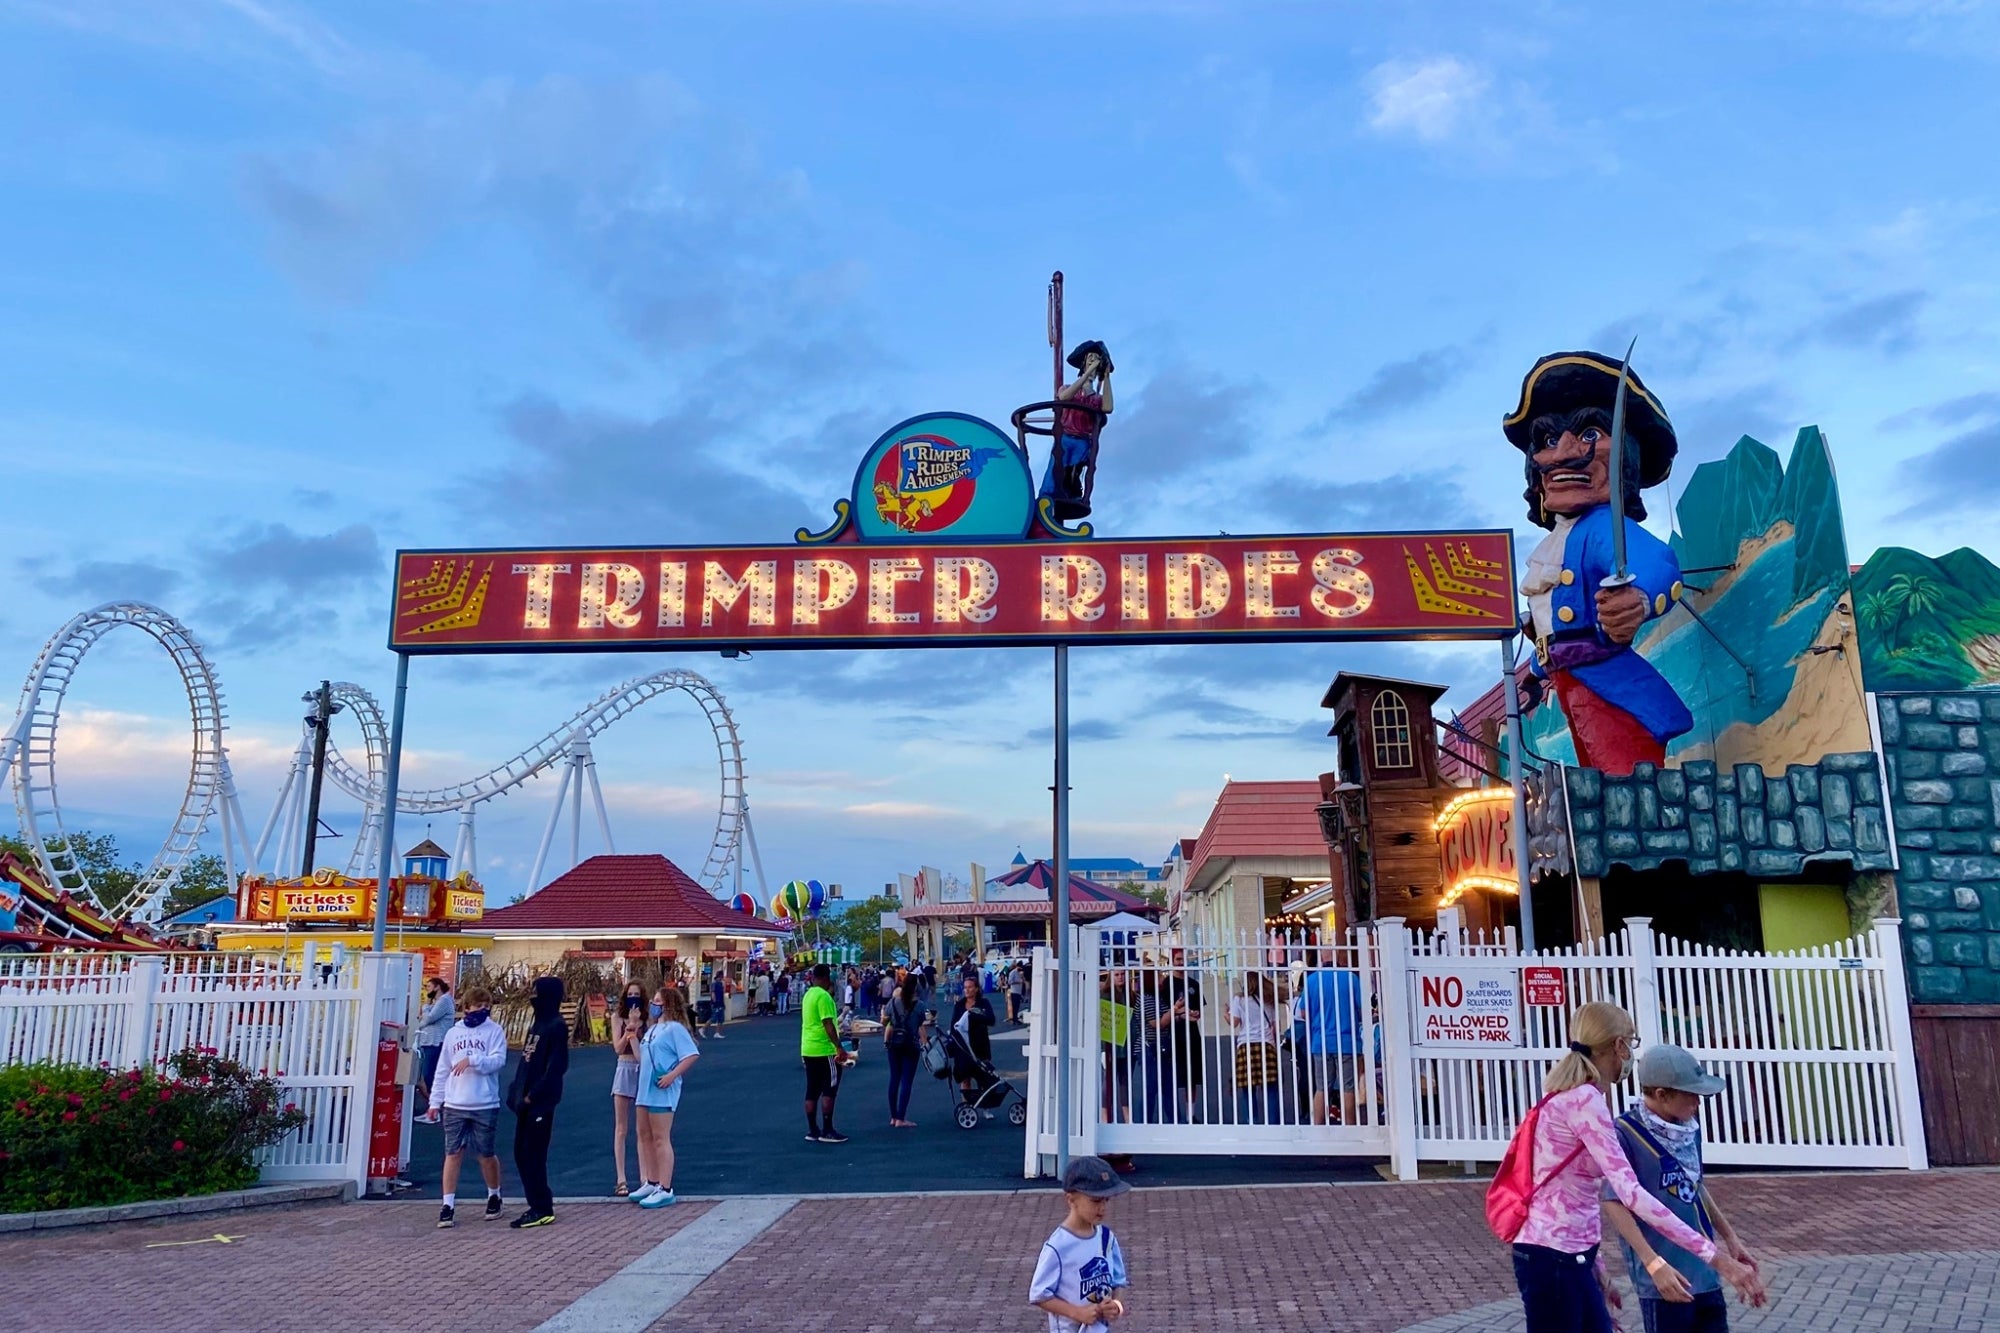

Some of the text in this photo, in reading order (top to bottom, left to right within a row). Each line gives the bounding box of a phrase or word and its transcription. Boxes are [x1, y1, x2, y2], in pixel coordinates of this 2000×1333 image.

[903, 442, 971, 463] TRIMPER
[917, 461, 958, 476] RIDES
[905, 467, 971, 489] AMUSEMENTS
[512, 548, 1374, 628] TRIMPER RIDES
[1442, 807, 1514, 883] COVE
[284, 893, 356, 905] Tickets
[452, 895, 481, 907] Tickets
[289, 904, 350, 914] ALL RIDES
[1479, 980, 1499, 989] BIKES
[1422, 976, 1463, 1008] NO
[1466, 989, 1512, 997] SKATEBOARDS
[1467, 999, 1513, 1007] ROLLER SKATES
[1427, 1014, 1508, 1028] ALLOWED
[1426, 1029, 1511, 1042] IN THIS PARK
